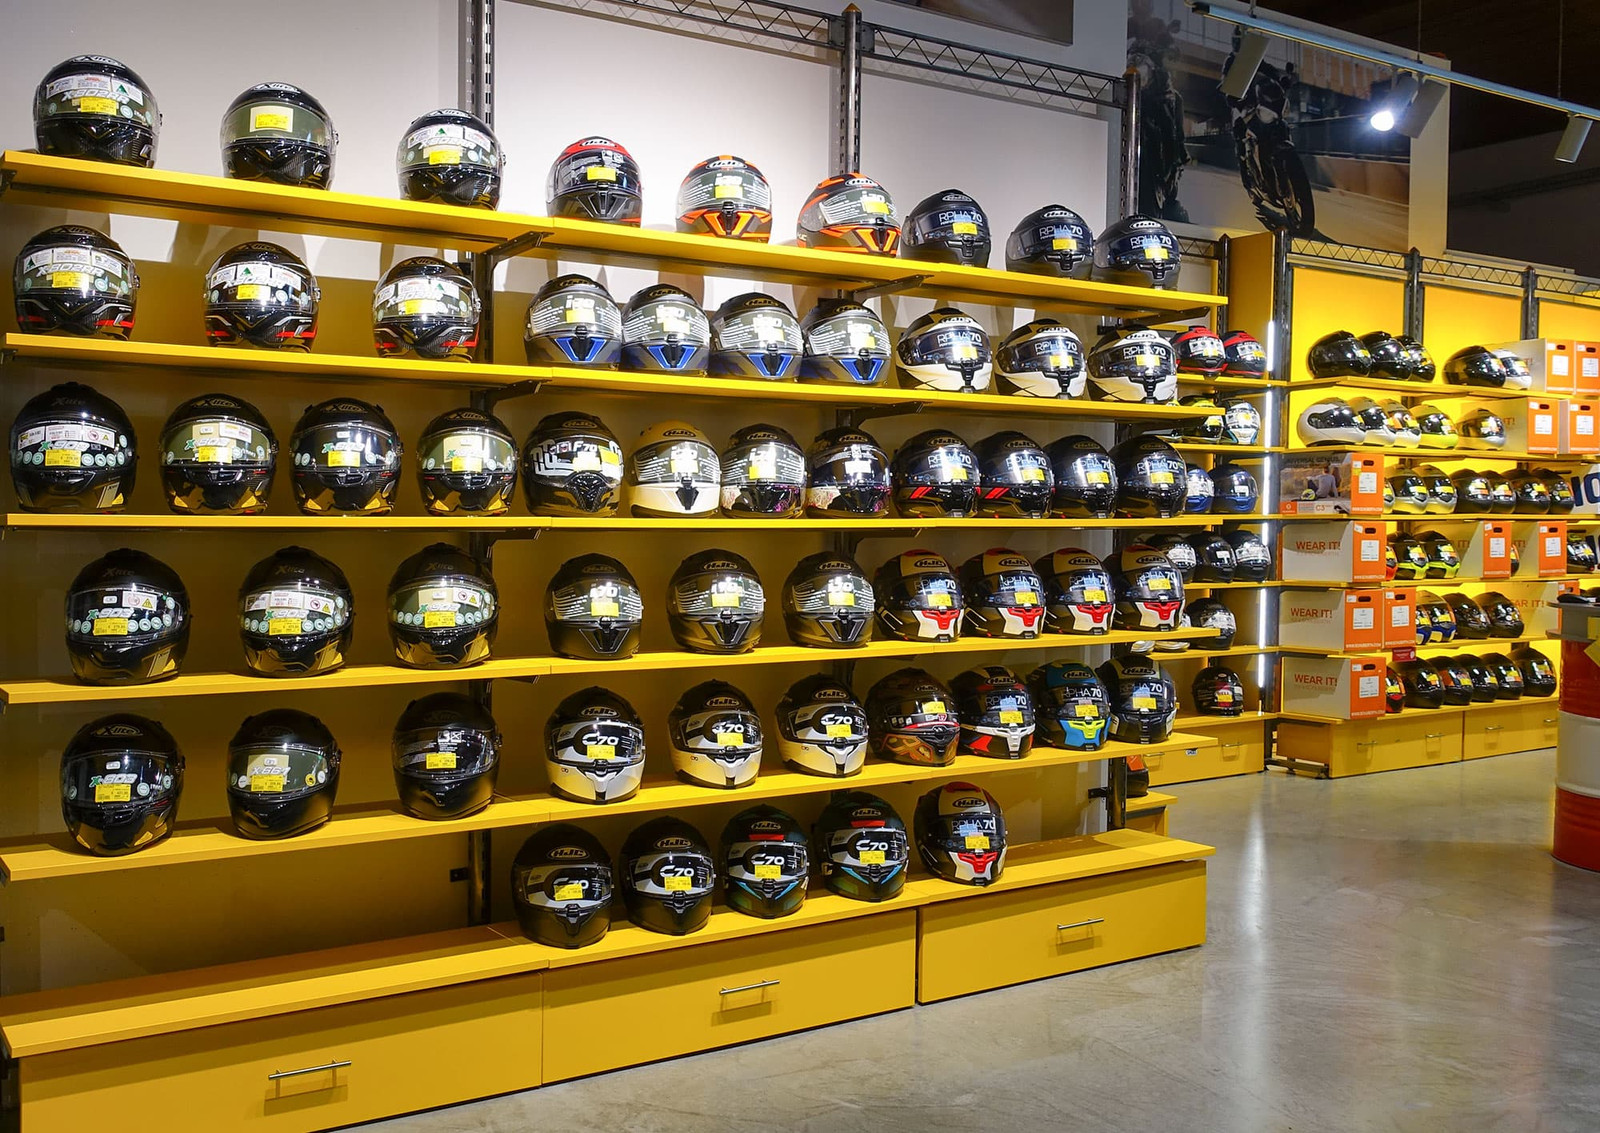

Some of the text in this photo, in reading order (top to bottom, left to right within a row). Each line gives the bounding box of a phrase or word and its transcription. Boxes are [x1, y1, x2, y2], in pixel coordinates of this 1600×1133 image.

[61, 88, 130, 104] X-802RR
[938, 211, 983, 225] RPHA 70
[1039, 224, 1083, 237] RPHA 70
[1130, 235, 1172, 248] RPHA 70
[36, 263, 106, 278] X-802RR
[936, 331, 982, 345] RPHA 70
[1066, 340, 1078, 351] 70
[1122, 345, 1167, 357] RPHA 70
[1036, 456, 1047, 466] 70
[1168, 460, 1178, 470] 70
[1295, 540, 1341, 551] WEAR IT!
[945, 578, 957, 590] 70
[1531, 599, 1546, 608] IT!
[1290, 607, 1333, 619] WEAR IT!
[1293, 673, 1338, 687] WEAR IT!
[1062, 686, 1102, 698] RPHA 70
[1015, 694, 1027, 706] 70
[820, 713, 854, 726] C70
[711, 721, 745, 733] C70
[581, 733, 619, 746] C70
[855, 839, 890, 852] C70
[750, 853, 786, 866] C70
[659, 864, 695, 878] C70
